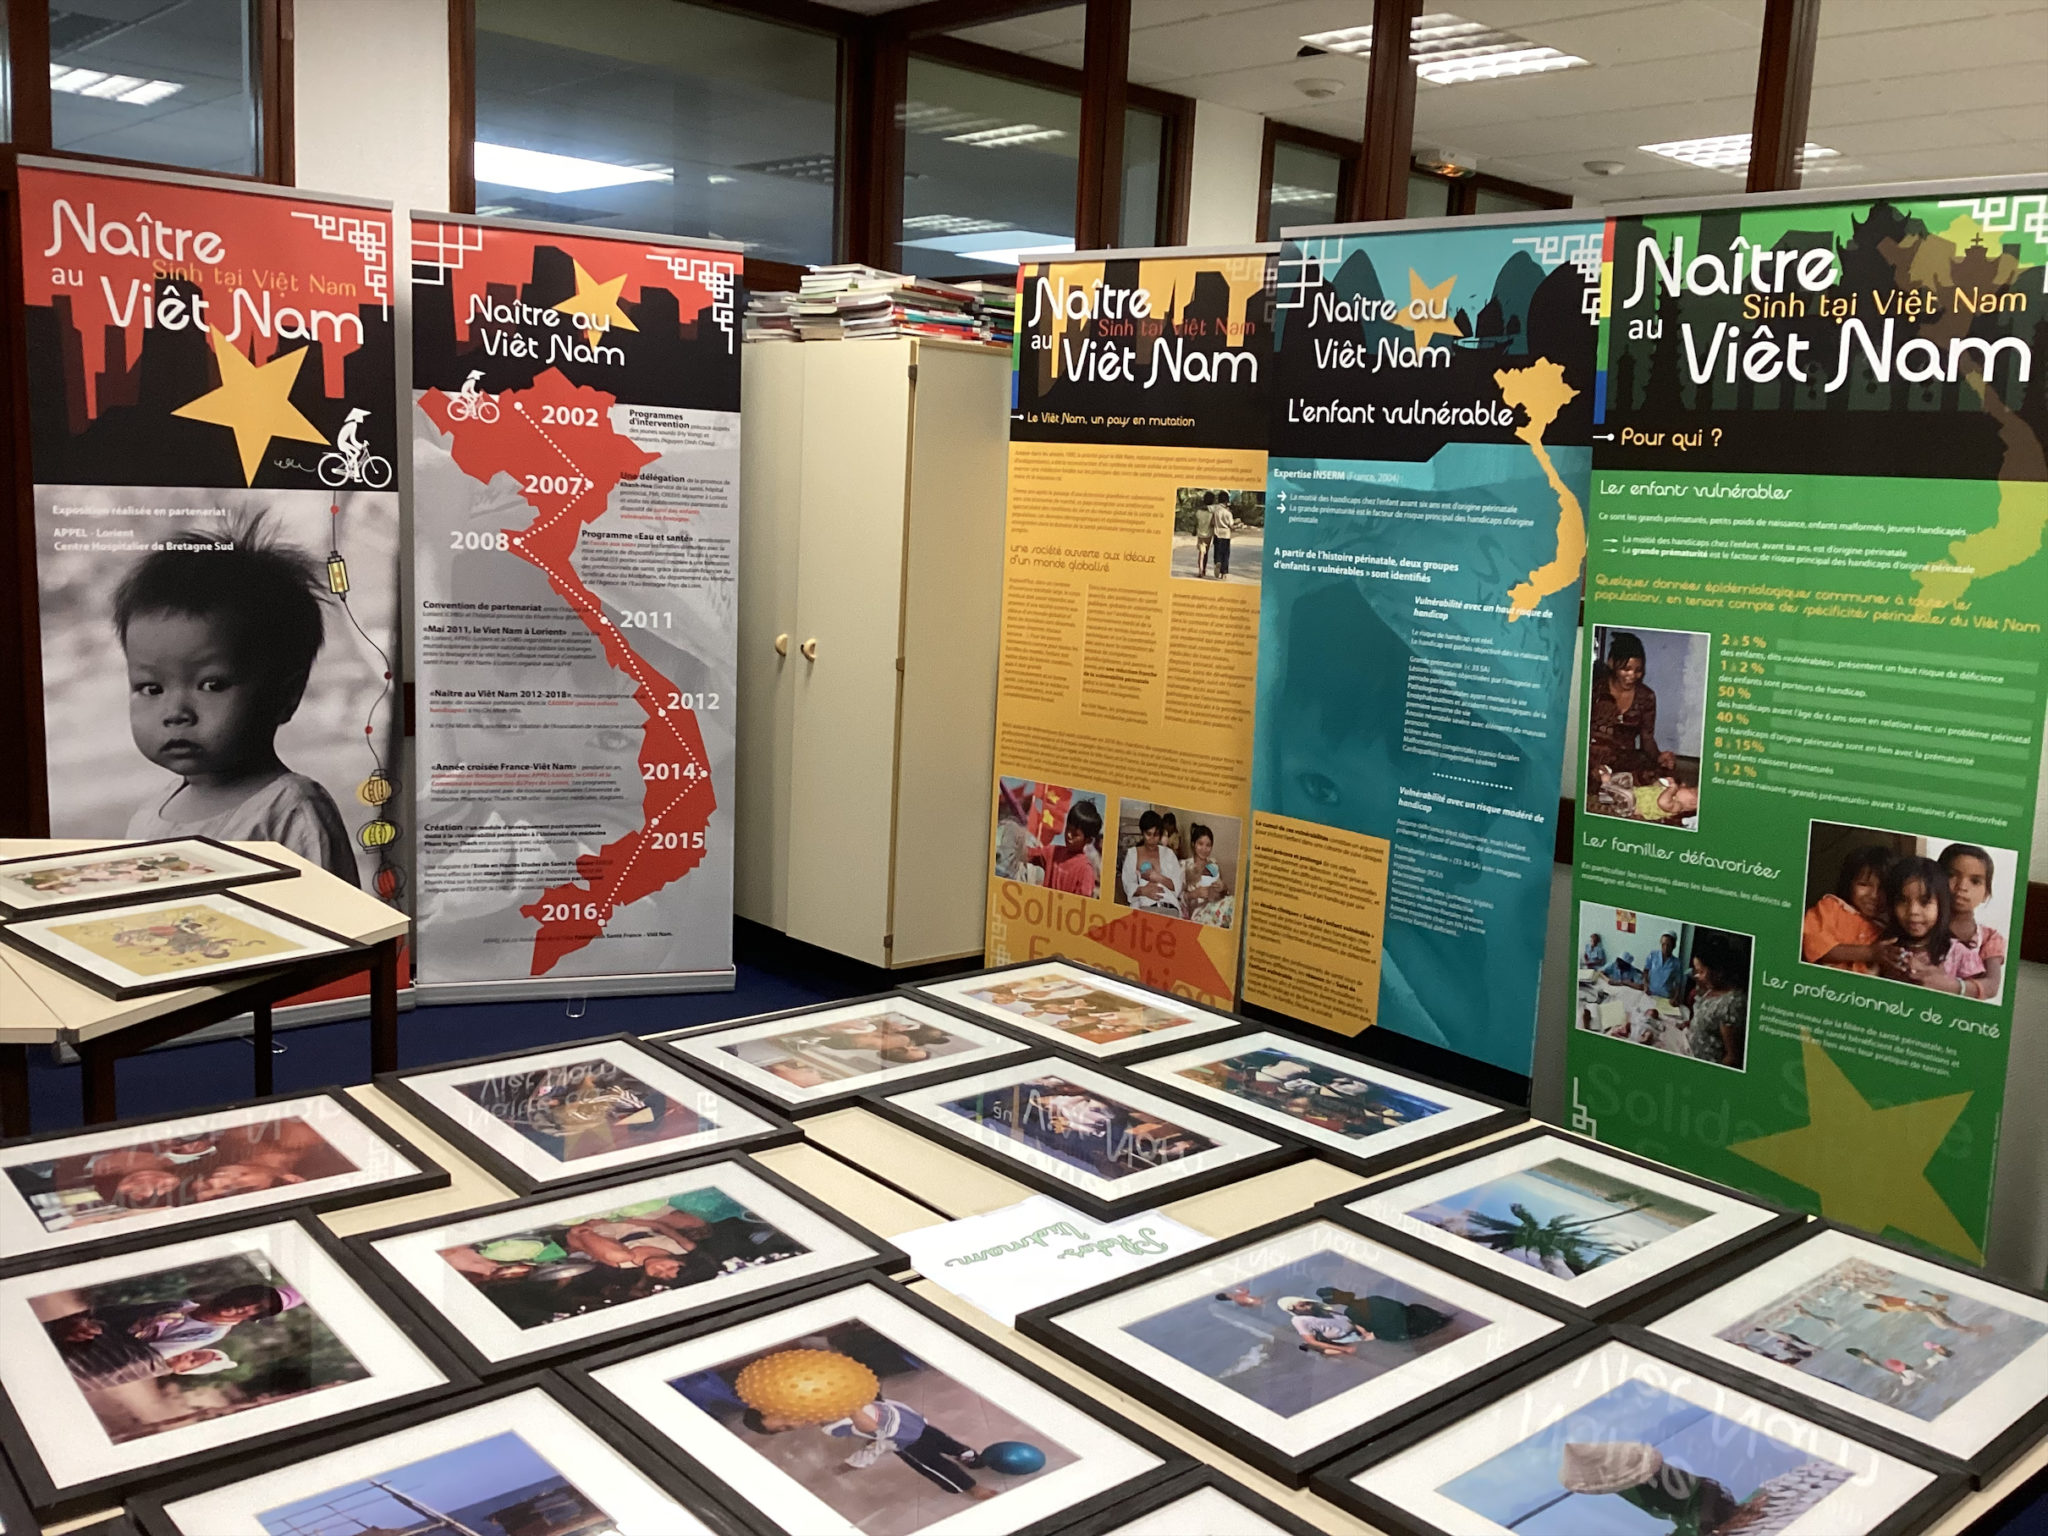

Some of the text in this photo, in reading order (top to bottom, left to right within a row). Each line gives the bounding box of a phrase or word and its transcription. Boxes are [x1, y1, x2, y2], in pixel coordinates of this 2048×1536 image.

[44, 199, 225, 264] Naître
[51, 266, 84, 287] au
[152, 260, 357, 298] Sinh tại Việt Nam
[1623, 236, 1838, 308] Naître
[101, 276, 365, 345] Viêt Nam
[465, 294, 611, 332] Naître au
[1028, 277, 1153, 328] Naître
[1308, 291, 1448, 328] Naître au
[1742, 287, 2027, 324] Sinh tại Việt Nam
[1098, 319, 1134, 337] Sinh
[1215, 320, 1256, 337] Nam
[1628, 316, 1663, 340] au
[480, 328, 625, 367] Viêt Nam
[1031, 334, 1053, 350] au
[1063, 338, 1258, 389] Viêt Nam
[1314, 337, 1451, 374] Viêt Nam
[1681, 318, 2032, 392] Viêt Nam
[541, 405, 599, 428] 2002
[629, 409, 683, 420] Programmes
[629, 417, 689, 428] d'intervention
[1028, 412, 1195, 427] Le Viêt Nam, un pays en mutation
[1288, 398, 1514, 427] L'enfant vulnérable
[1621, 427, 1723, 451] Pour qui ?
[640, 473, 685, 482] délégation
[1274, 468, 1345, 481] Expertise INSERM
[524, 475, 582, 496] 2007
[1600, 480, 1792, 500] Les enfants vulnérables
[54, 528, 134, 538] APPEL Lorient
[450, 531, 510, 552] 2008
[582, 530, 632, 539] Programme
[152, 542, 164, 552] de
[166, 541, 212, 552] Bretagne
[214, 541, 234, 550] Sud
[1010, 554, 1110, 572] d'un monde globalisé
[1274, 547, 1459, 572] A partir de l'histoire périnatale, deux groupes
[1274, 560, 1431, 583] d'enfants vulnérables sont identifiés
[423, 601, 476, 610] Convention
[1413, 608, 1448, 620] handicap
[1414, 596, 1462, 609] Vulnérabilité
[1462, 603, 1482, 611] avec
[1541, 609, 1553, 618] de
[447, 625, 471, 633] 2011,
[473, 626, 481, 634] le
[620, 610, 673, 629] 2011
[667, 692, 720, 711] 2012
[1718, 686, 1751, 699] 50 %
[1717, 711, 1749, 725] 40 %
[642, 763, 696, 781] 2014
[1398, 798, 1432, 812] handicap
[1400, 786, 1445, 802] Vulnérabilité
[1446, 798, 1464, 807] avec
[1476, 803, 1501, 814] risque
[1502, 808, 1533, 820] modéré
[1534, 814, 1544, 823] de
[651, 832, 704, 851] 2015
[1583, 832, 1781, 880] Les familles défavorisées
[542, 903, 598, 922] 2016
[1001, 881, 1177, 958] Solidarité
[1762, 971, 2001, 1039] Les professionnels de santé
